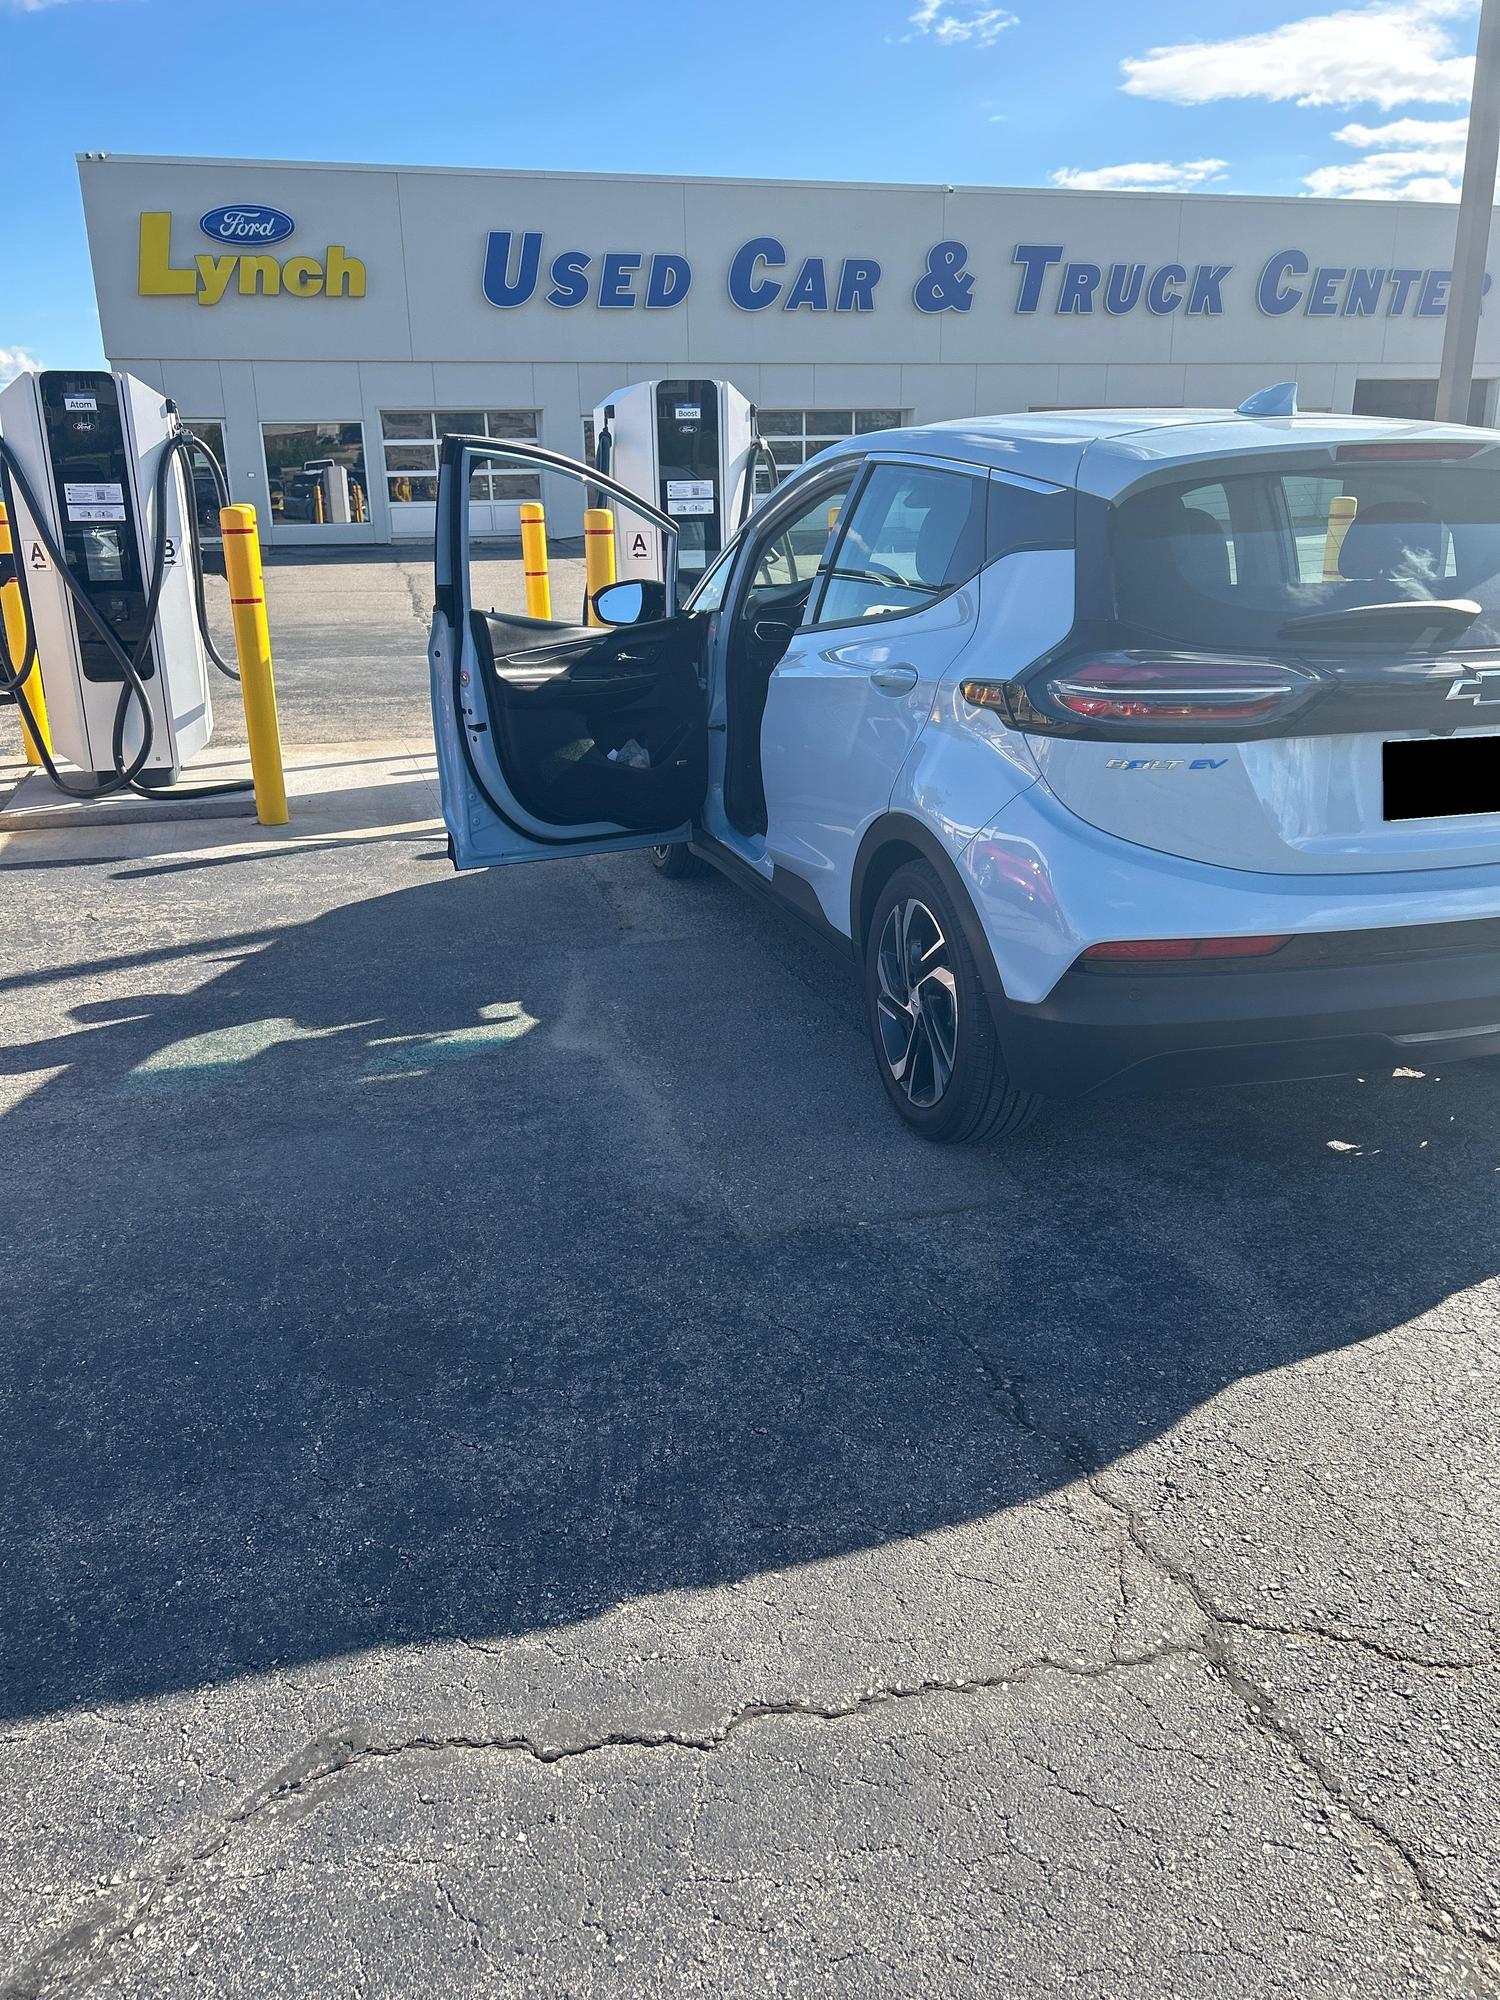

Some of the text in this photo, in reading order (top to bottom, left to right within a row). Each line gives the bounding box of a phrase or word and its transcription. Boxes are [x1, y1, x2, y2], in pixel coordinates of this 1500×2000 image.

[219, 210, 276, 236] Ford
[138, 211, 367, 305] Lynch
[481, 231, 691, 309] USED
[727, 237, 881, 312] CAR
[913, 241, 976, 314] &
[1012, 243, 1234, 316] TRUCK
[70, 400, 92, 408] Atom
[632, 534, 647, 551] A
[31, 543, 46, 562] A
[1188, 759, 1228, 770] EV
